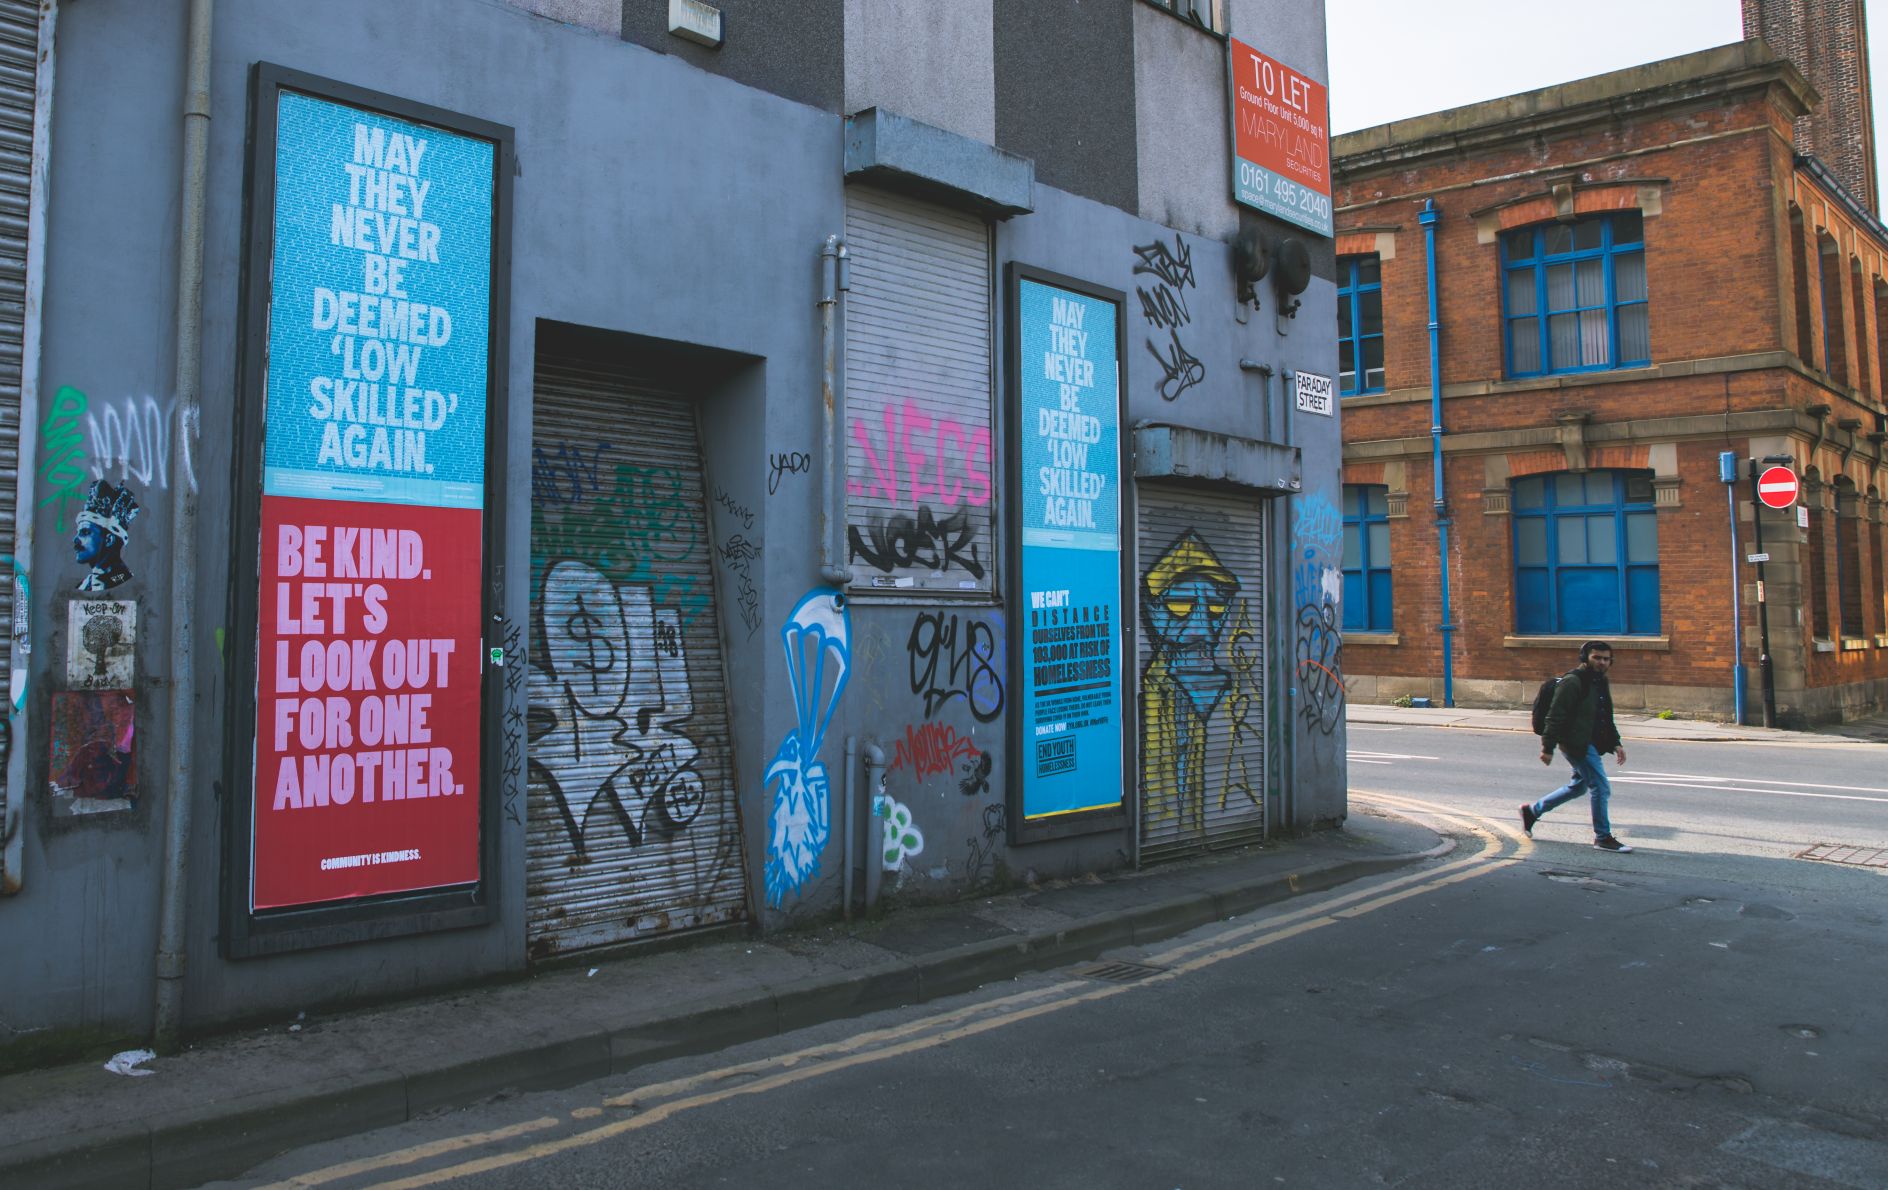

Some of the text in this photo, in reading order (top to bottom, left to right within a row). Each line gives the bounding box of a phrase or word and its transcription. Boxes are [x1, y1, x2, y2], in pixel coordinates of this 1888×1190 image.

[1250, 53, 1311, 114] TO LET
[1239, 85, 1263, 109] Ground
[1263, 97, 1279, 118] Floor
[1279, 106, 1292, 124] Unit
[1310, 125, 1318, 139] sq
[353, 123, 428, 177] MAY
[1241, 107, 1323, 169] MARYLAND
[1286, 157, 1322, 183] SECURITIES
[345, 163, 430, 219] THEY
[1241, 162, 1328, 220] 0161 495 2040
[331, 203, 441, 264] NEVER
[364, 253, 408, 300] BE
[312, 287, 451, 347] DEEMED
[1053, 297, 1085, 329] MAY
[1049, 324, 1088, 358] THEY
[1044, 351, 1094, 388] NEVER
[1297, 374, 1331, 396] FARADAY
[1060, 383, 1081, 414] BE
[1299, 392, 1327, 410] STREET
[1039, 407, 1101, 445] DEEMED
[317, 421, 435, 474] AGAIN.
[1044, 498, 1096, 529] AGAIN.
[277, 524, 432, 580] BE KIND.
[276, 582, 388, 635] LET'S
[1031, 589, 1070, 609] WE CAN'T
[1032, 604, 1109, 627] DISTANCE
[1033, 622, 1110, 645] OURSELVES FROM THE
[1069, 641, 1078, 660] AT
[1079, 639, 1099, 659] RISK
[1100, 638, 1110, 656] OF
[275, 639, 377, 693] LOOK
[382, 638, 455, 689] OUT
[1034, 657, 1111, 687] HOMELESSNESS
[274, 693, 432, 752] FOR ONE
[1035, 723, 1054, 737] DONATE
[1054, 721, 1067, 734] NOW
[1038, 738, 1074, 759] END YOUTH
[1038, 757, 1075, 774] HOMELESSNESS
[273, 747, 464, 810] ANOTHER.
[320, 848, 421, 871] COMMUNITY IS KINDNESS.
